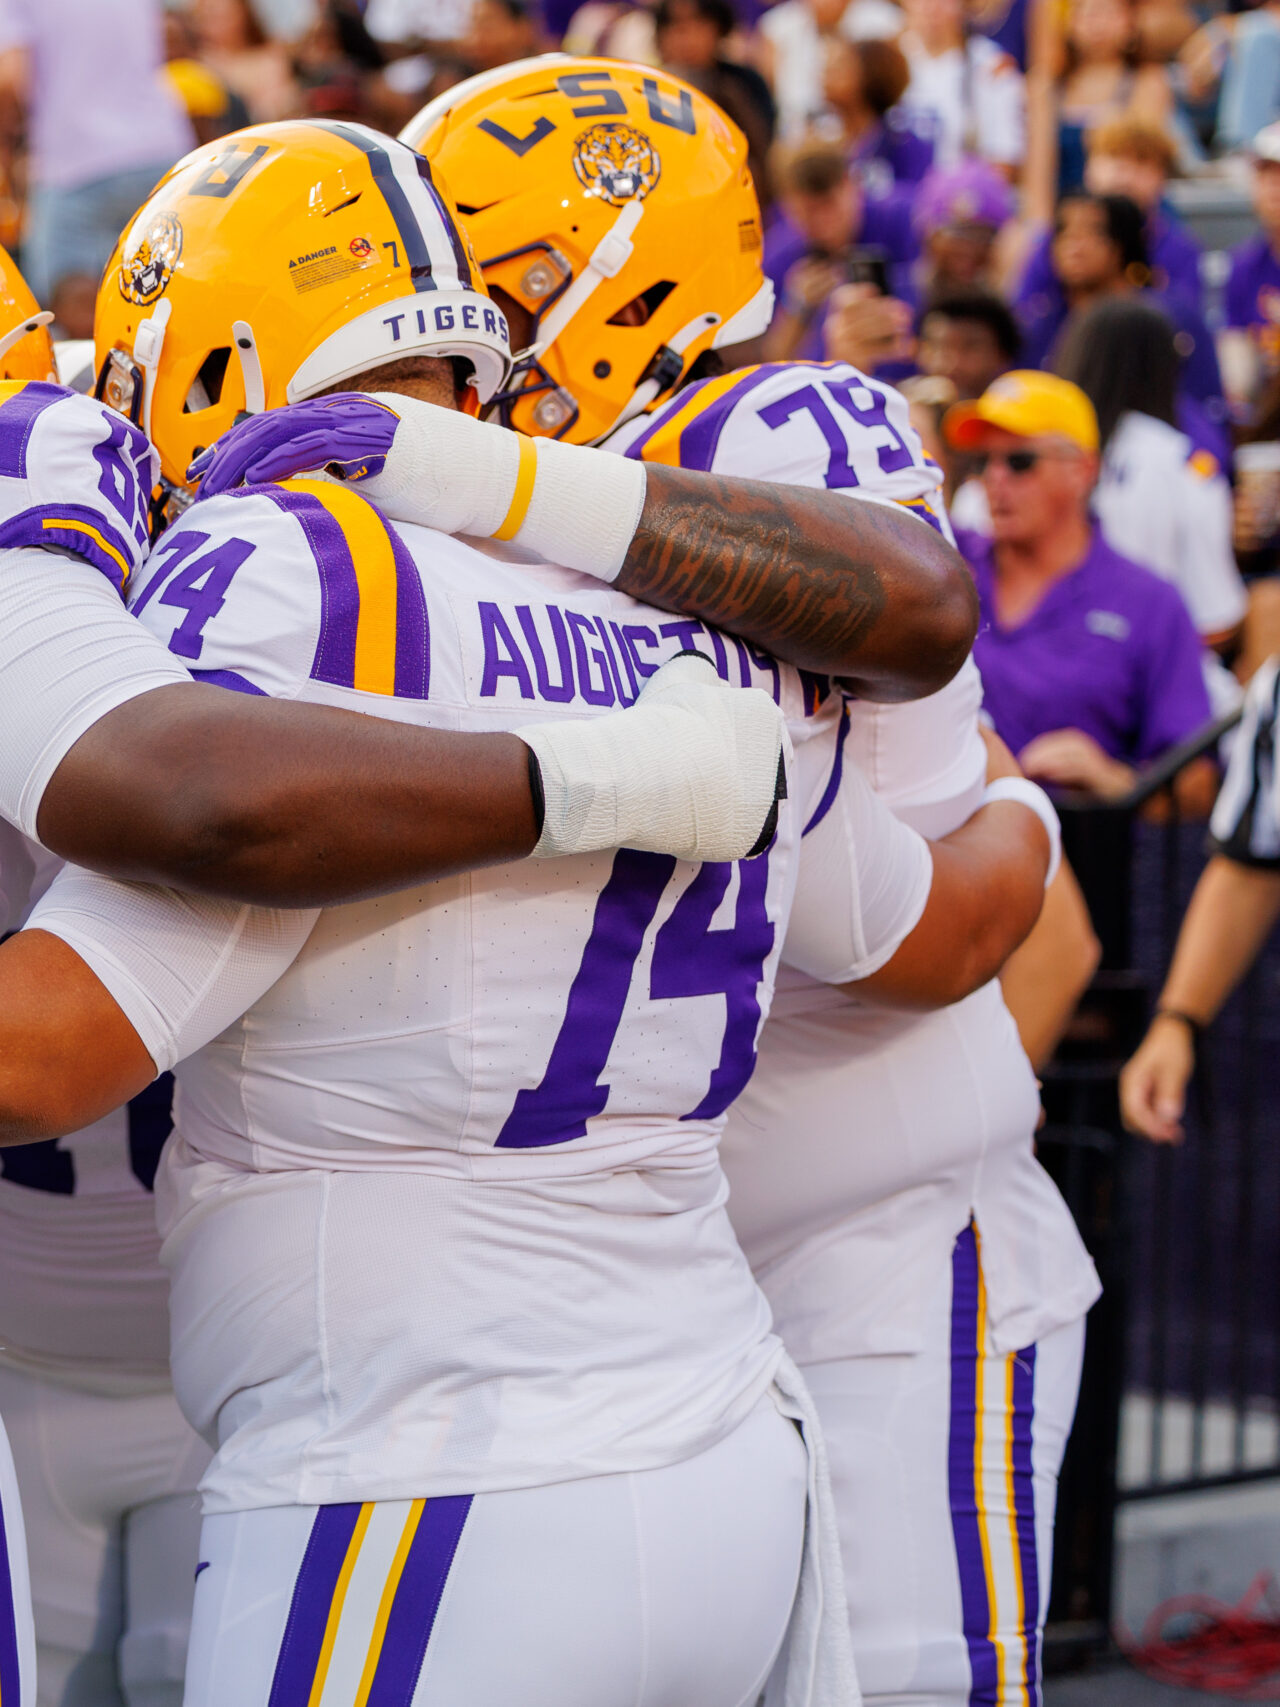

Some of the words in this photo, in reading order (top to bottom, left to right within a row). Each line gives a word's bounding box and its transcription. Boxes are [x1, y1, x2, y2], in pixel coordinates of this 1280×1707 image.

[477, 72, 697, 157] LSU
[297, 246, 337, 264] DANGER
[382, 241, 400, 268] 7
[383, 305, 508, 343] TIGERS
[756, 377, 915, 489] 79
[127, 531, 256, 660] 74
[493, 847, 775, 1148] 74
